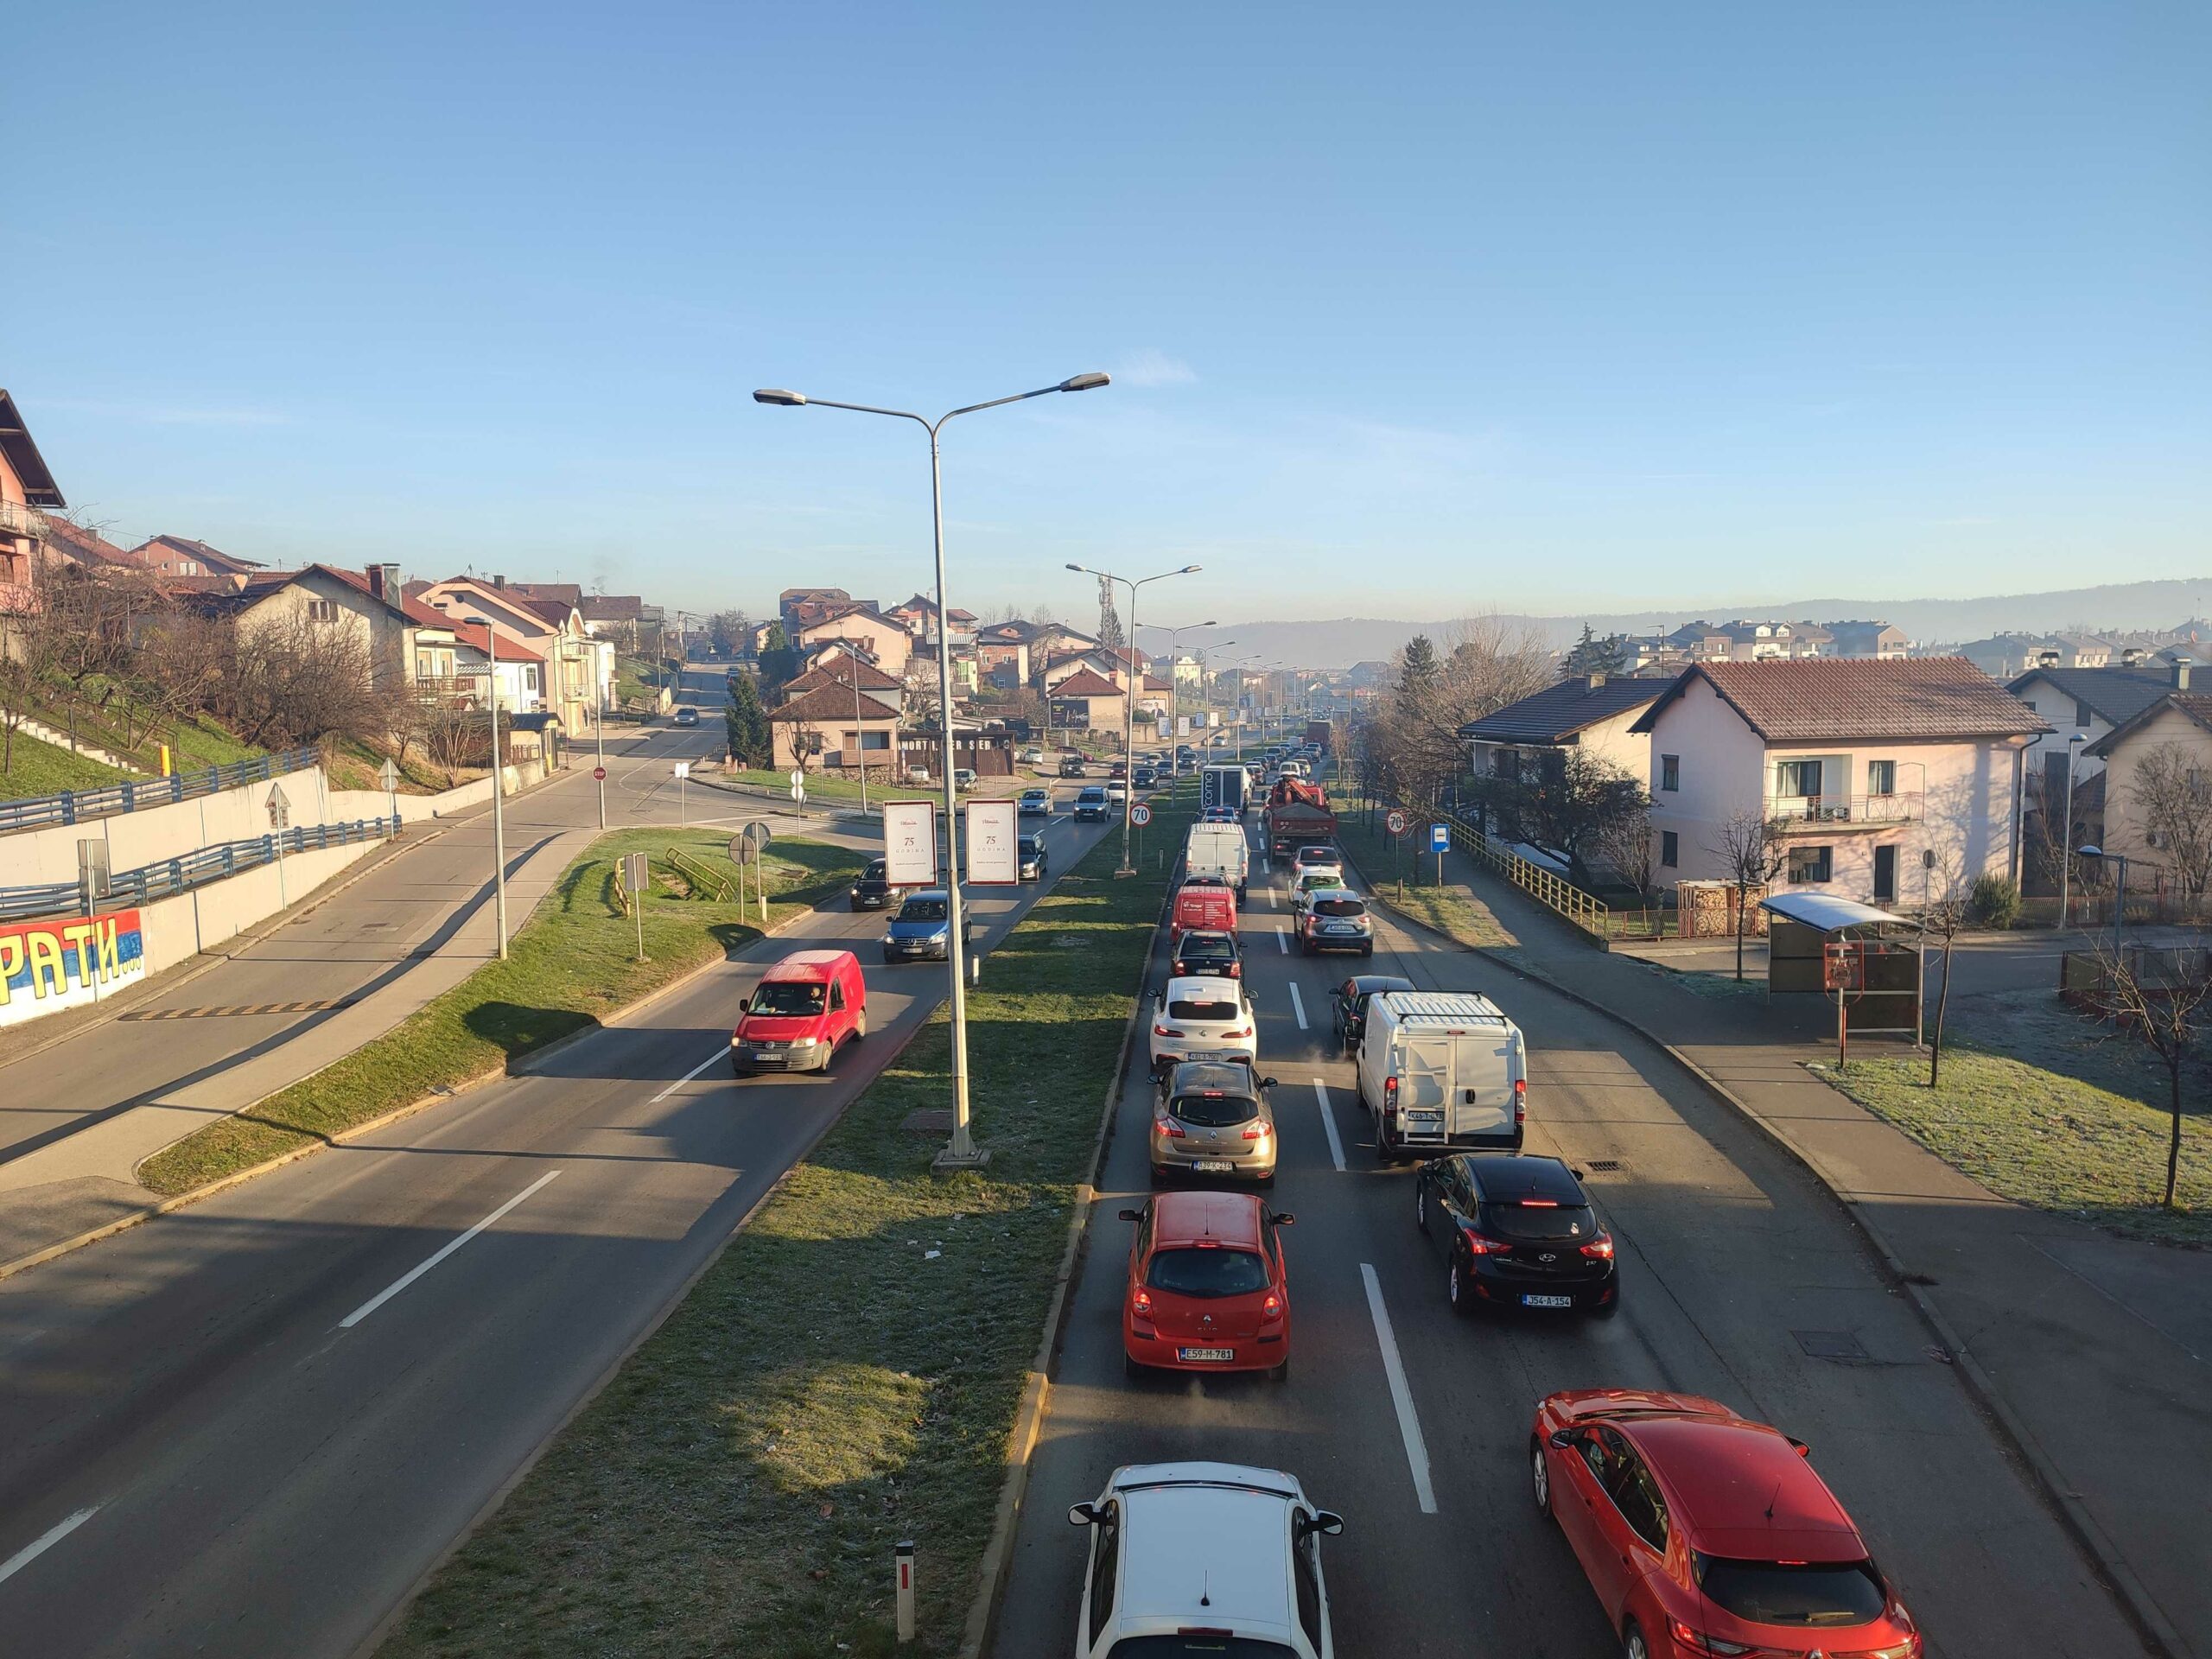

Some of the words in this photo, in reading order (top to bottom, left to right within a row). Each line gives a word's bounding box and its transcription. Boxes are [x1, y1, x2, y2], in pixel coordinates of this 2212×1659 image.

[1134, 809, 1147, 821] 70
[1390, 817, 1402, 828] 70
[905, 837, 914, 846] 75
[986, 836, 996, 844] 75
[1528, 1296, 1570, 1306] J54-A-154
[1186, 1350, 1231, 1359] E59-M-781
